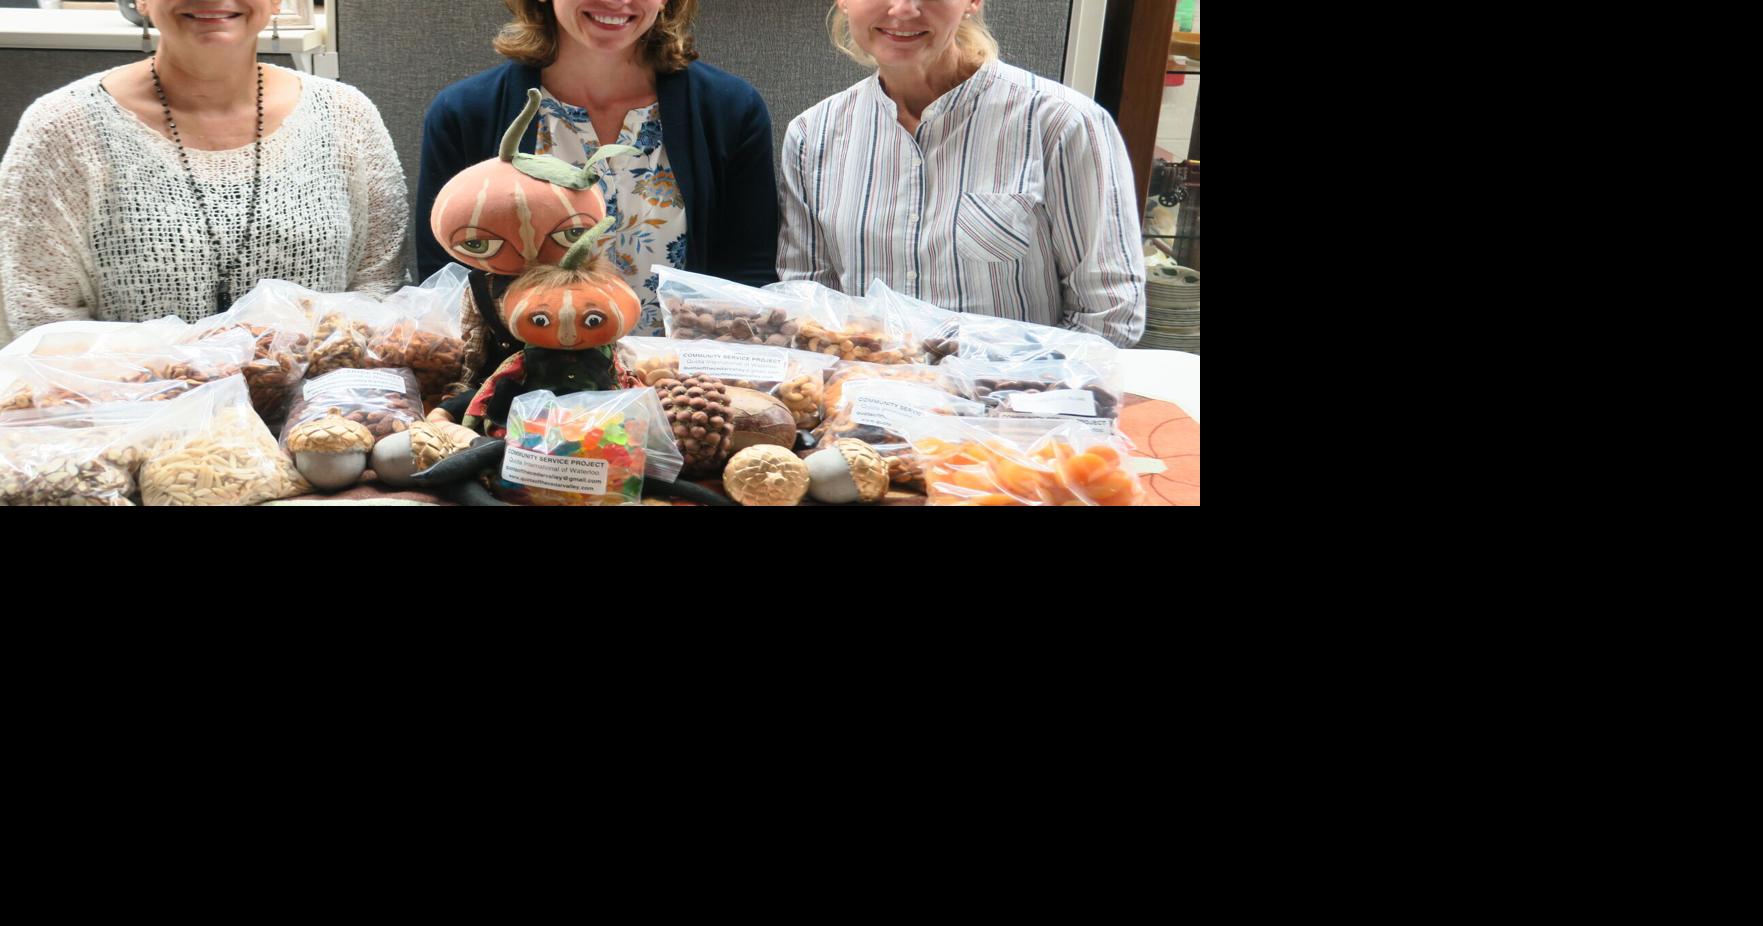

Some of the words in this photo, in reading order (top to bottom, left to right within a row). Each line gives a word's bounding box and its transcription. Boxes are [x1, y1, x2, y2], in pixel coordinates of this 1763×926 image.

[858, 396, 898, 408] COMMUNITY
[508, 448, 538, 460] COMMUNITY
[540, 456, 568, 465] SERVICE
[571, 460, 604, 468] PROJECT
[570, 468, 600, 476] Waterloo
